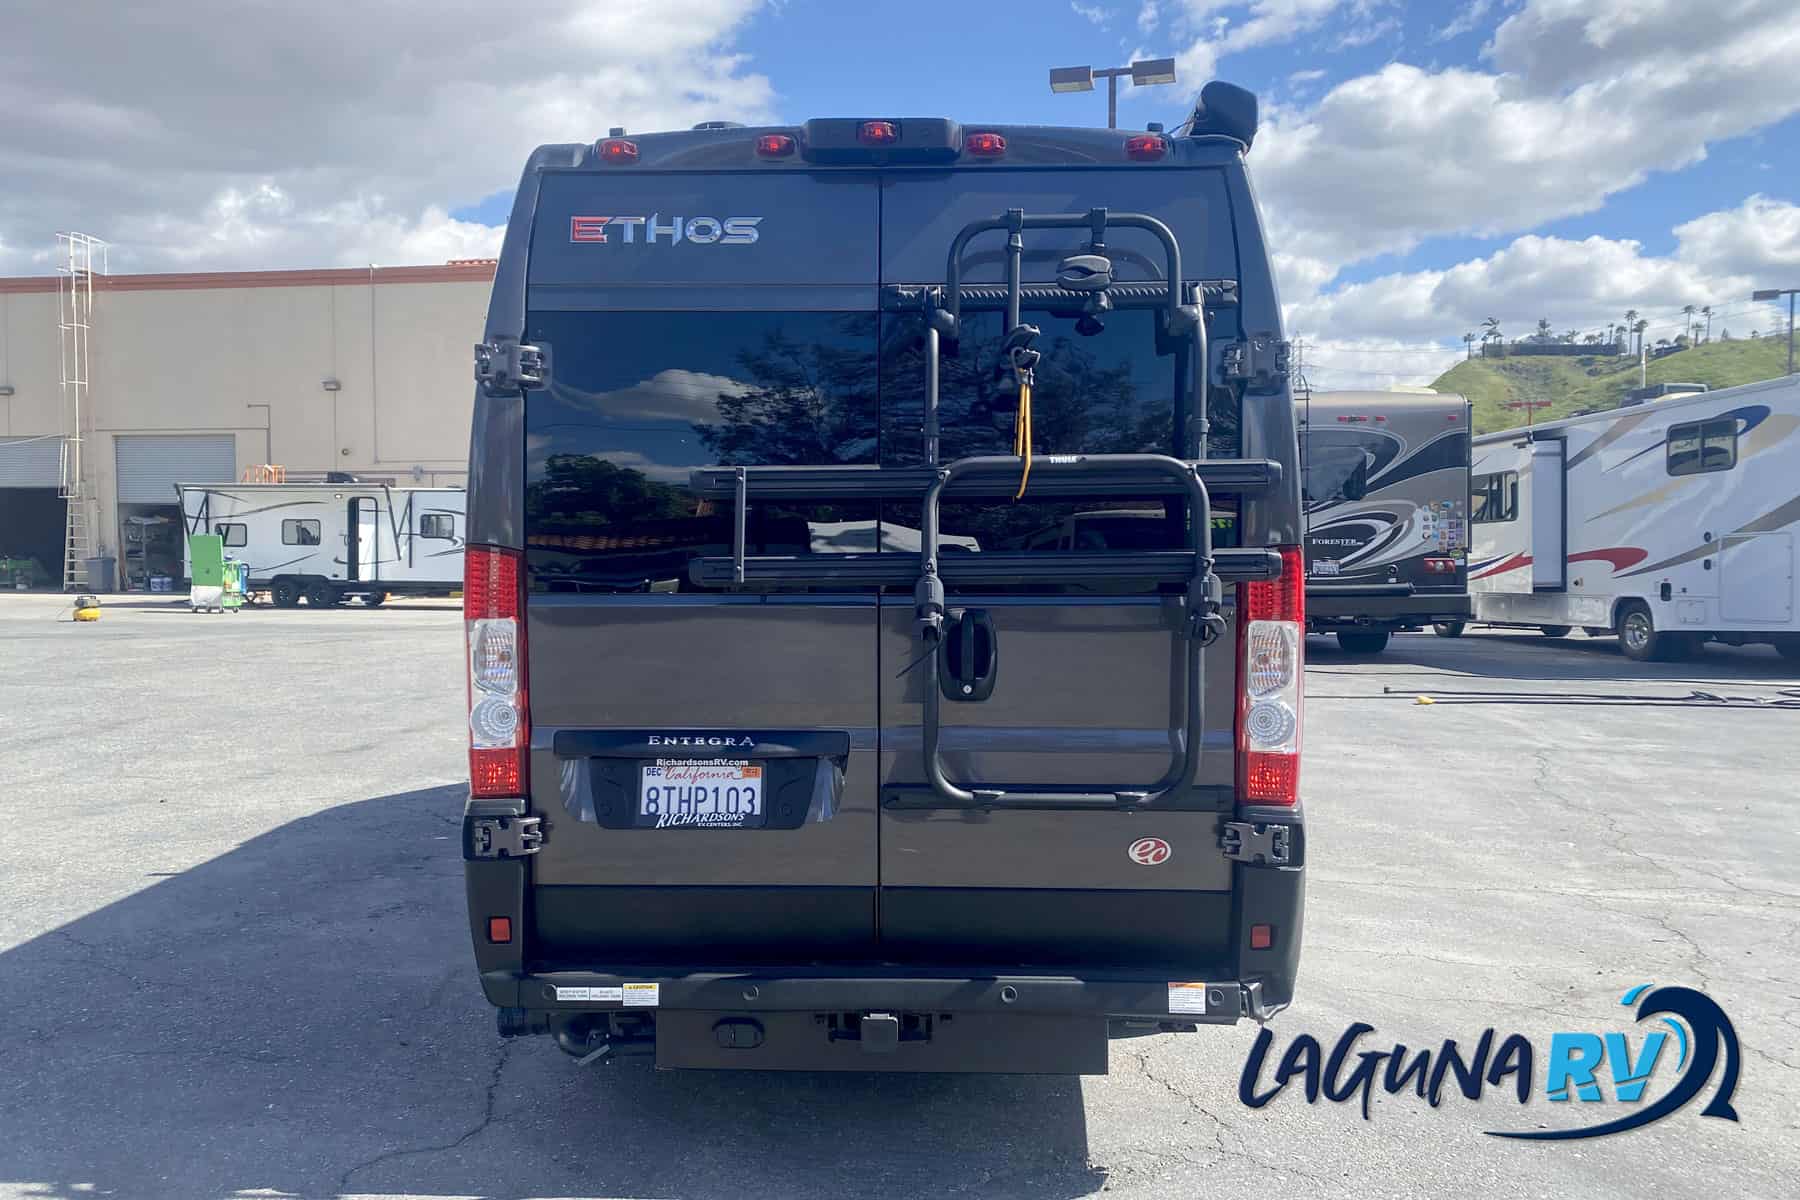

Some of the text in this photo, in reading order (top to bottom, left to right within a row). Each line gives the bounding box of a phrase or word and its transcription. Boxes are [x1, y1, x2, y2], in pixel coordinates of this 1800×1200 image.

[569, 213, 765, 247] ETHOS
[648, 735, 755, 746] ENTEGRA
[656, 758, 749, 767] RichardsonsRV.com
[646, 767, 662, 776] DEC
[664, 766, 742, 785] California
[645, 786, 756, 815] 8THP103
[655, 812, 745, 828] RICHARDSONS
